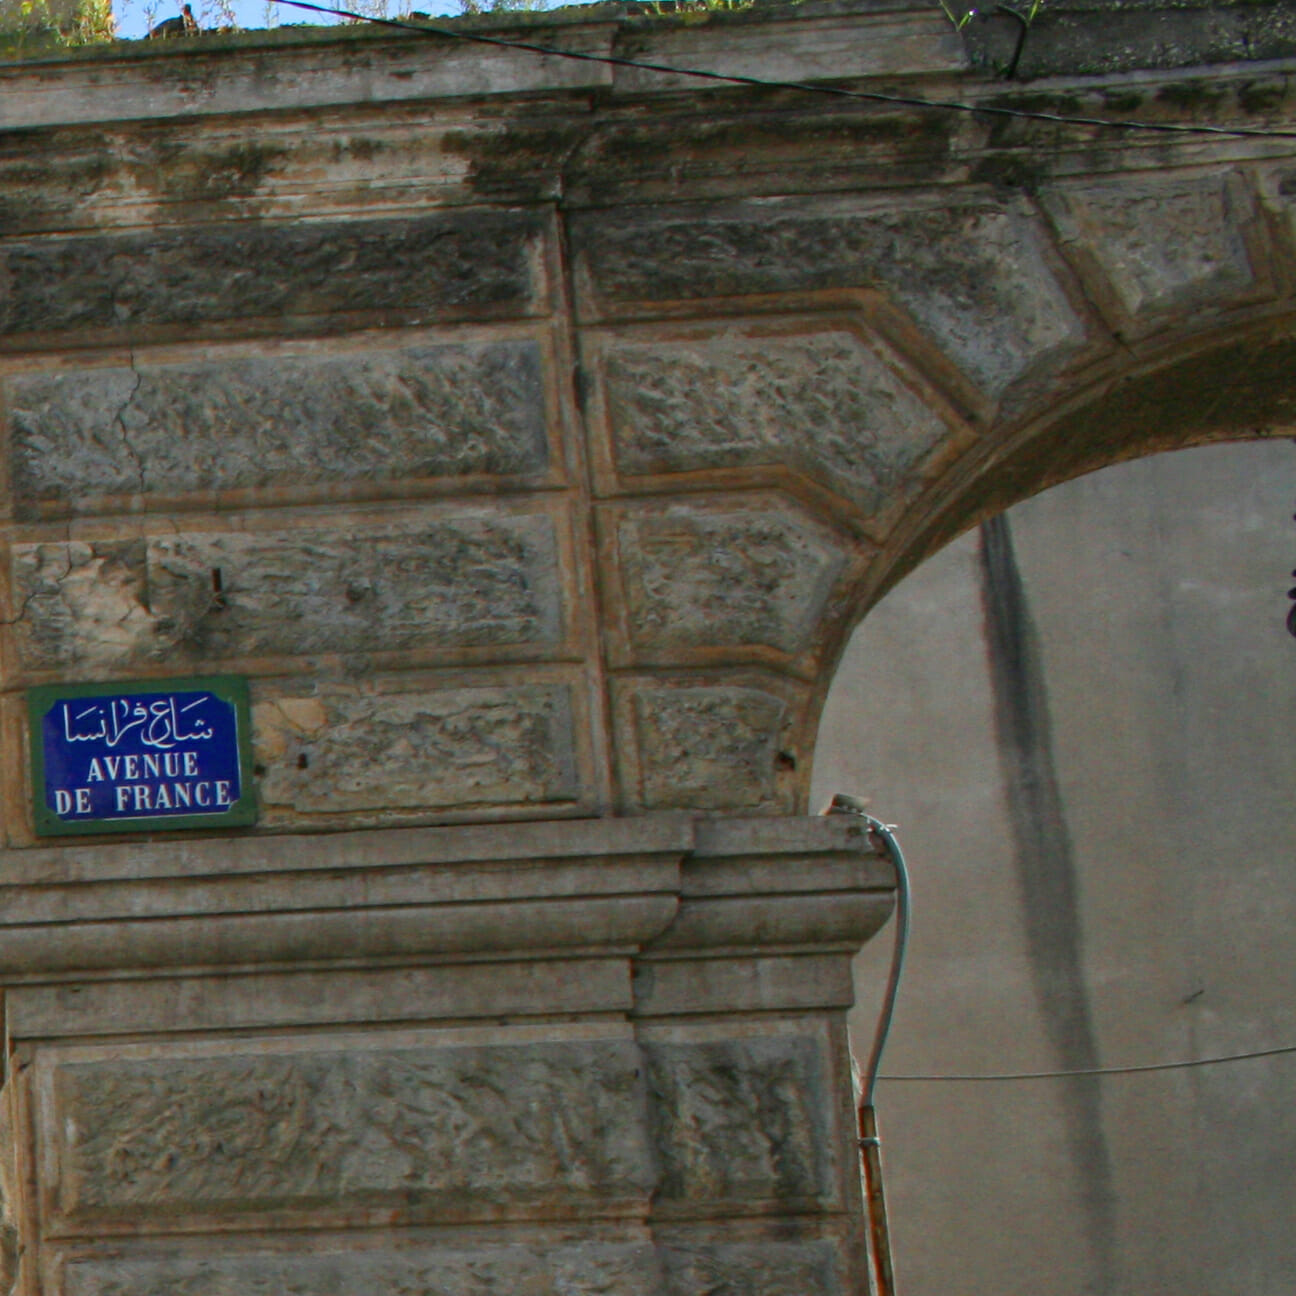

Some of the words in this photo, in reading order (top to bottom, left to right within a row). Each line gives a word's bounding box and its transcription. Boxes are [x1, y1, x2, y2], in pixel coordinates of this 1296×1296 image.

[63, 699, 149, 747] فرانسا
[141, 696, 214, 749] شارع
[86, 752, 199, 783] AVENUE
[55, 788, 92, 815] DE
[115, 780, 232, 812] FRANCE
